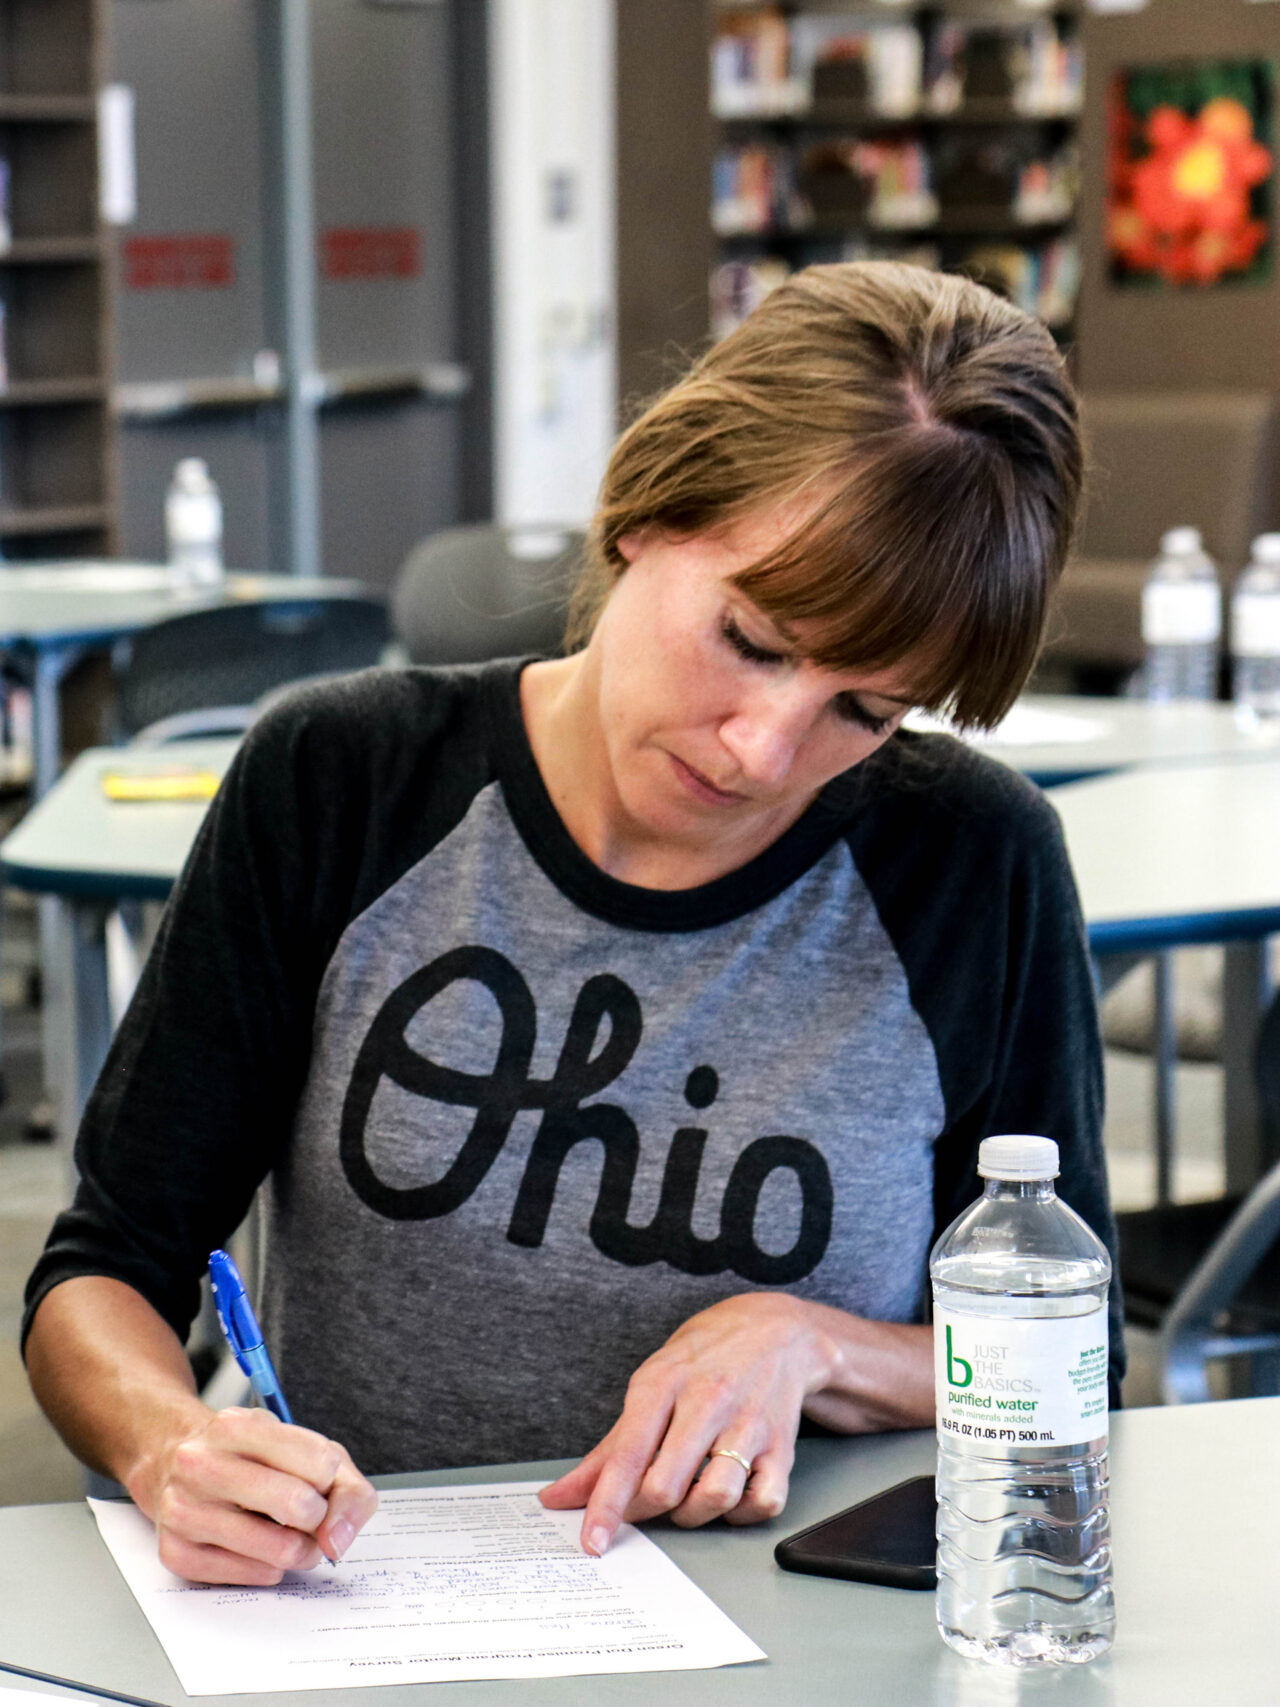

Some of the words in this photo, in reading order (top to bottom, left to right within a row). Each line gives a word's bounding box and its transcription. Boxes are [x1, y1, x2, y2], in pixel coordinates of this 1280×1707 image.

[340, 945, 834, 1285] Ohio
[945, 1324, 973, 1388] b
[973, 1344, 1009, 1360] JUST
[974, 1361, 1005, 1376] THE
[948, 1391, 993, 1409] purified
[996, 1398, 1039, 1412] water
[951, 1407, 965, 1418] with
[966, 1409, 1002, 1423] minerals
[1003, 1414, 1033, 1424] added
[952, 1422, 960, 1433] FL
[961, 1424, 972, 1436] OZ
[973, 1427, 998, 1439] (1.05
[999, 1429, 1016, 1442] PT)
[1018, 1430, 1038, 1441] 500
[1039, 1430, 1056, 1441] mL
